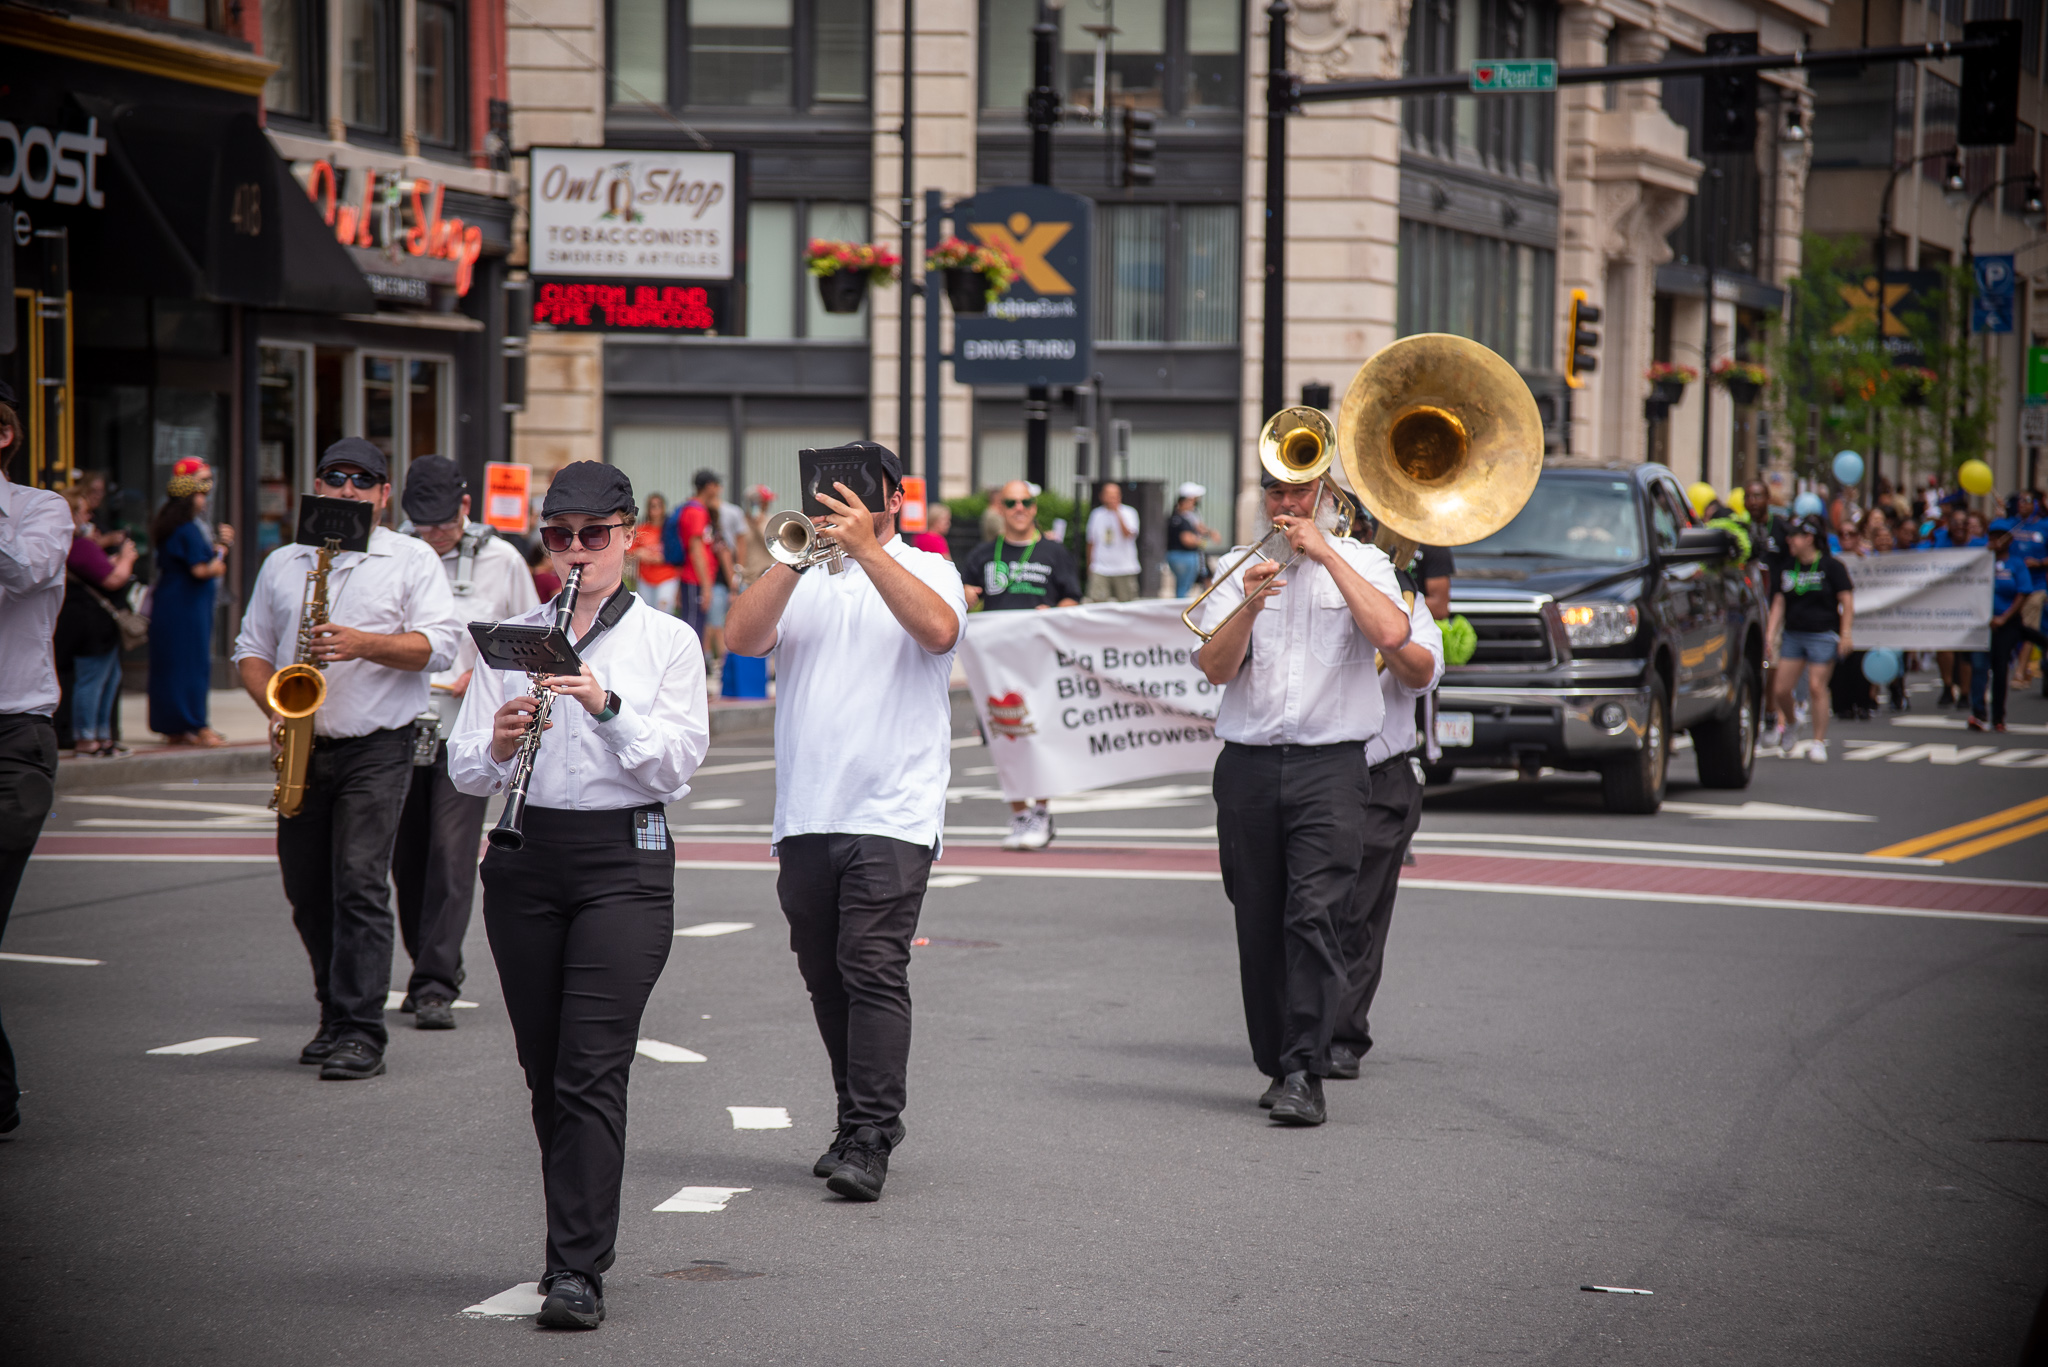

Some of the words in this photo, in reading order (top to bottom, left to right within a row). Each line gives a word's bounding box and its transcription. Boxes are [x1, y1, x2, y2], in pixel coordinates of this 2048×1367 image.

[1494, 64, 1538, 87] Pearl
[541, 164, 605, 203] Owl
[637, 168, 724, 220] Shop
[406, 177, 483, 297] Shop
[546, 225, 720, 246] TOBACCONISTS
[547, 251, 628, 265] SMOKERS
[637, 252, 720, 267] ARTICLES
[541, 283, 627, 306] CUSTOM
[635, 285, 708, 309] BLEND
[534, 302, 593, 326] PIPE
[605, 305, 714, 329] TOBACCOS
[963, 339, 1076, 360] DRIVE-THRU
[1103, 645, 1194, 669] Brothe
[1057, 676, 1100, 699] Big
[1062, 701, 1155, 730] Central
